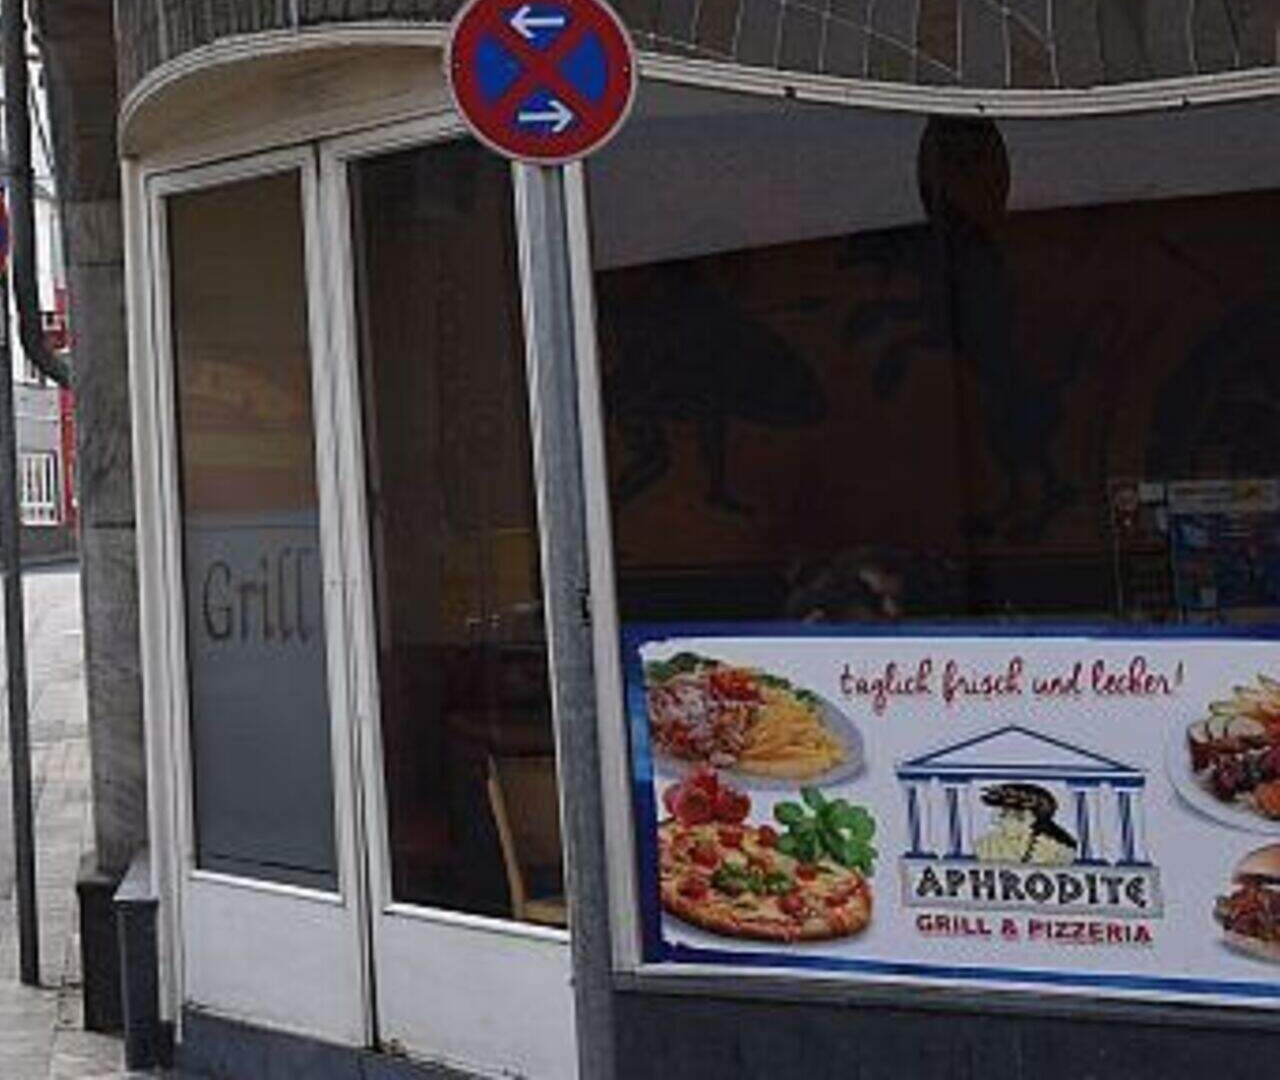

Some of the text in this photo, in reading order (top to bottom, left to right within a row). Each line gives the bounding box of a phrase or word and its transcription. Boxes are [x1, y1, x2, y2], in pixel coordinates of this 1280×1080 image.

[202, 546, 313, 645] Grill
[941, 656, 1024, 704] frisch
[1032, 661, 1082, 696] und
[916, 865, 1147, 908] APHRODITE
[915, 913, 1154, 944] GRILL & PIZZERIA
